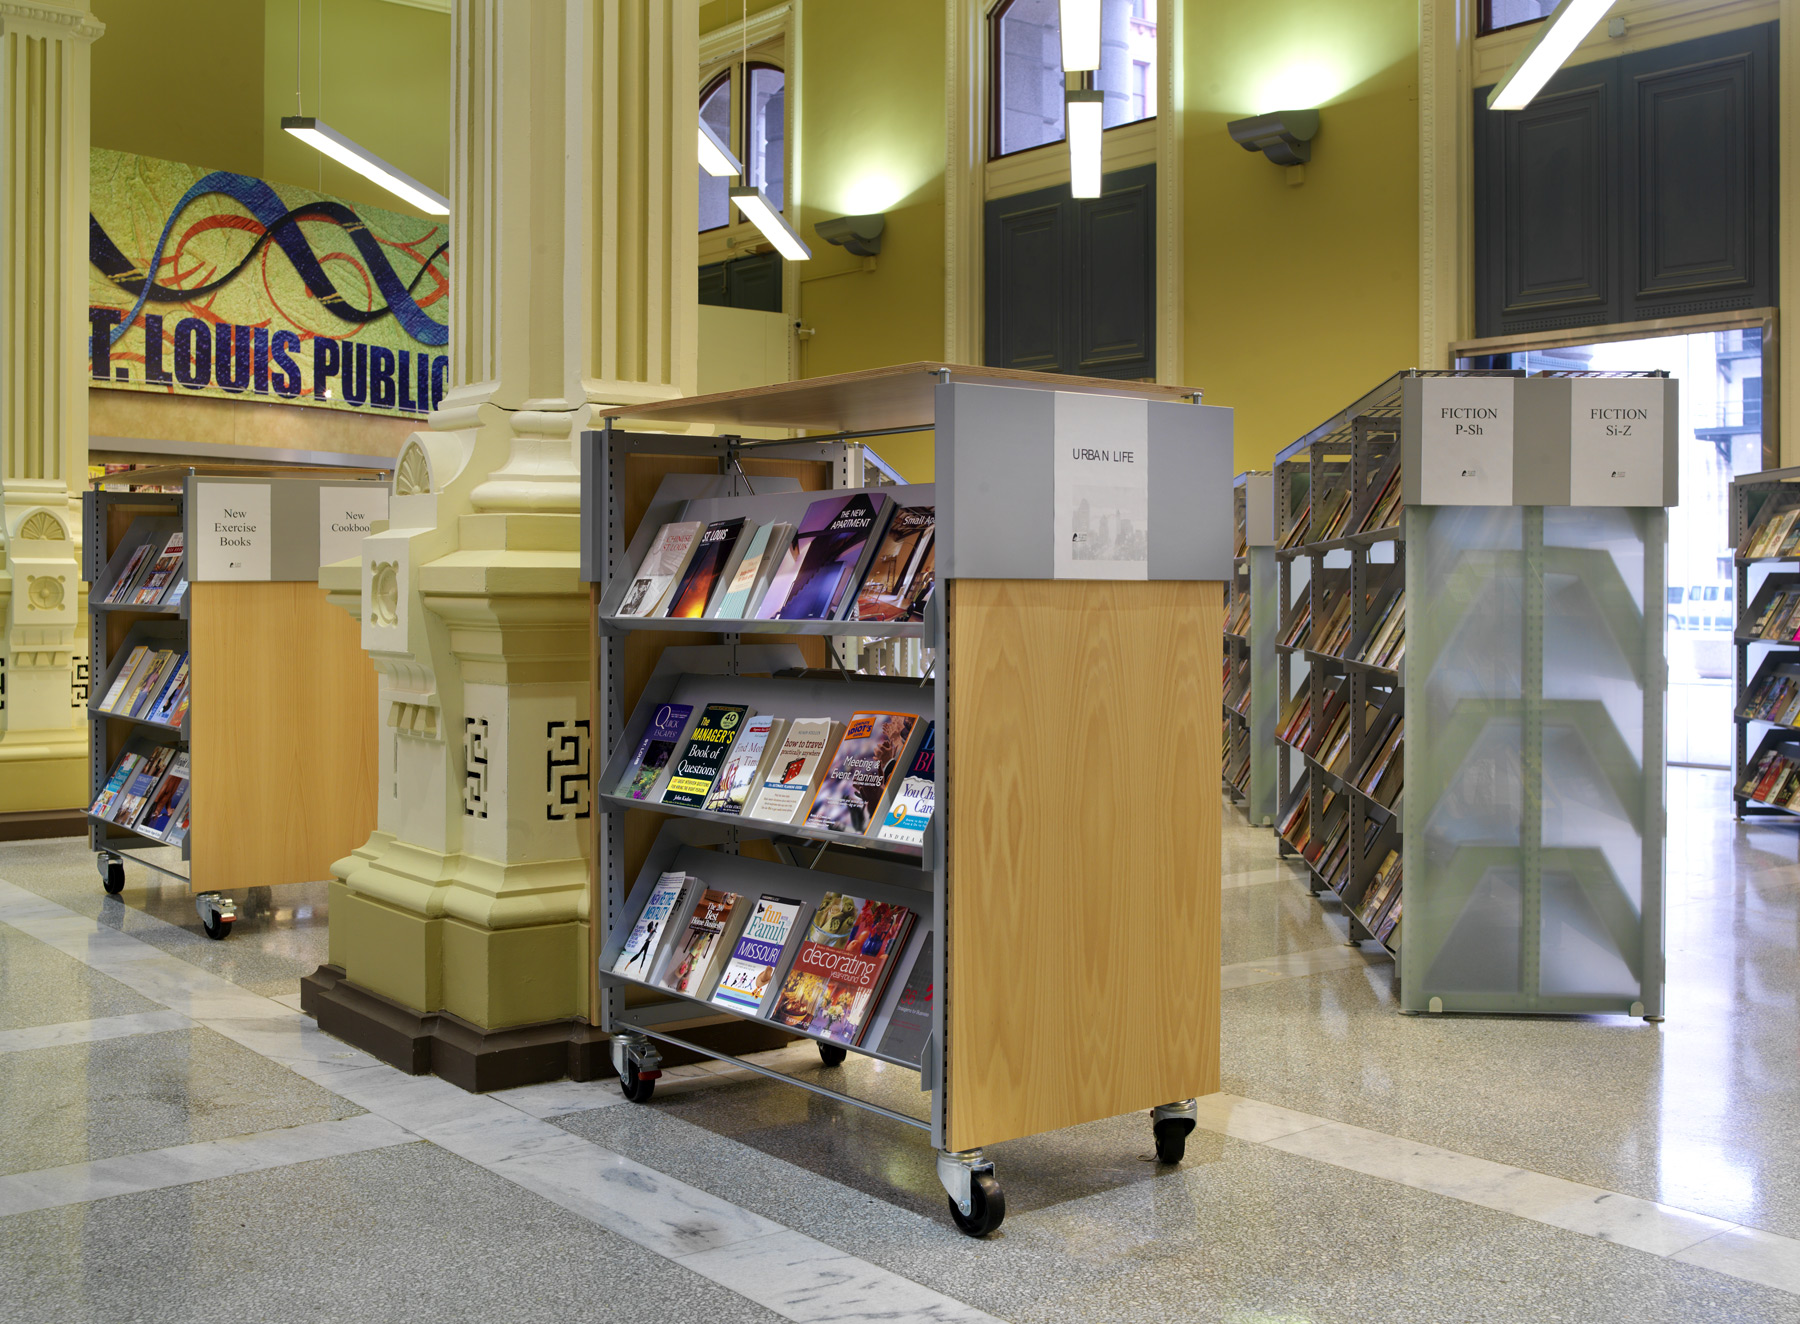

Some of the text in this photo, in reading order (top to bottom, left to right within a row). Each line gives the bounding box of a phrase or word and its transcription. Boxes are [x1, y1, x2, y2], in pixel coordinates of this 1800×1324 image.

[89, 308, 129, 382] T.
[145, 313, 301, 399] LOUIS
[1441, 408, 1498, 419] FICTION
[1590, 408, 1647, 420] FICTION
[1455, 424, 1483, 435] P-Sh
[1606, 425, 1632, 436] Si-Z
[1072, 448, 1134, 463] URBAN LIFE
[224, 508, 247, 519] New
[345, 511, 365, 520] New
[840, 508, 866, 518] THE NEW
[830, 518, 872, 530] APARTMENT
[903, 515, 935, 527] Small Apa
[214, 522, 257, 533] Exercise
[219, 536, 251, 547] Books
[725, 713, 737, 721] 40
[690, 727, 735, 744] MANAGER'S
[847, 725, 872, 736] IDIOT'S
[784, 737, 825, 749] how to travel
[688, 743, 723, 760] Book of
[677, 759, 717, 777] Questions
[843, 755, 881, 771] Meeting &
[913, 751, 935, 773] BI
[830, 767, 884, 787] Event Planning
[903, 783, 935, 800] You Cha
[888, 803, 907, 827] 9
[883, 832, 915, 843] ANDREA
[705, 910, 719, 921] Best
[762, 904, 782, 924] fun
[691, 916, 704, 926] Home
[747, 916, 788, 947] Family
[737, 941, 780, 963] MISSOURI
[802, 942, 876, 985] decorating
[829, 971, 859, 983] year-round
